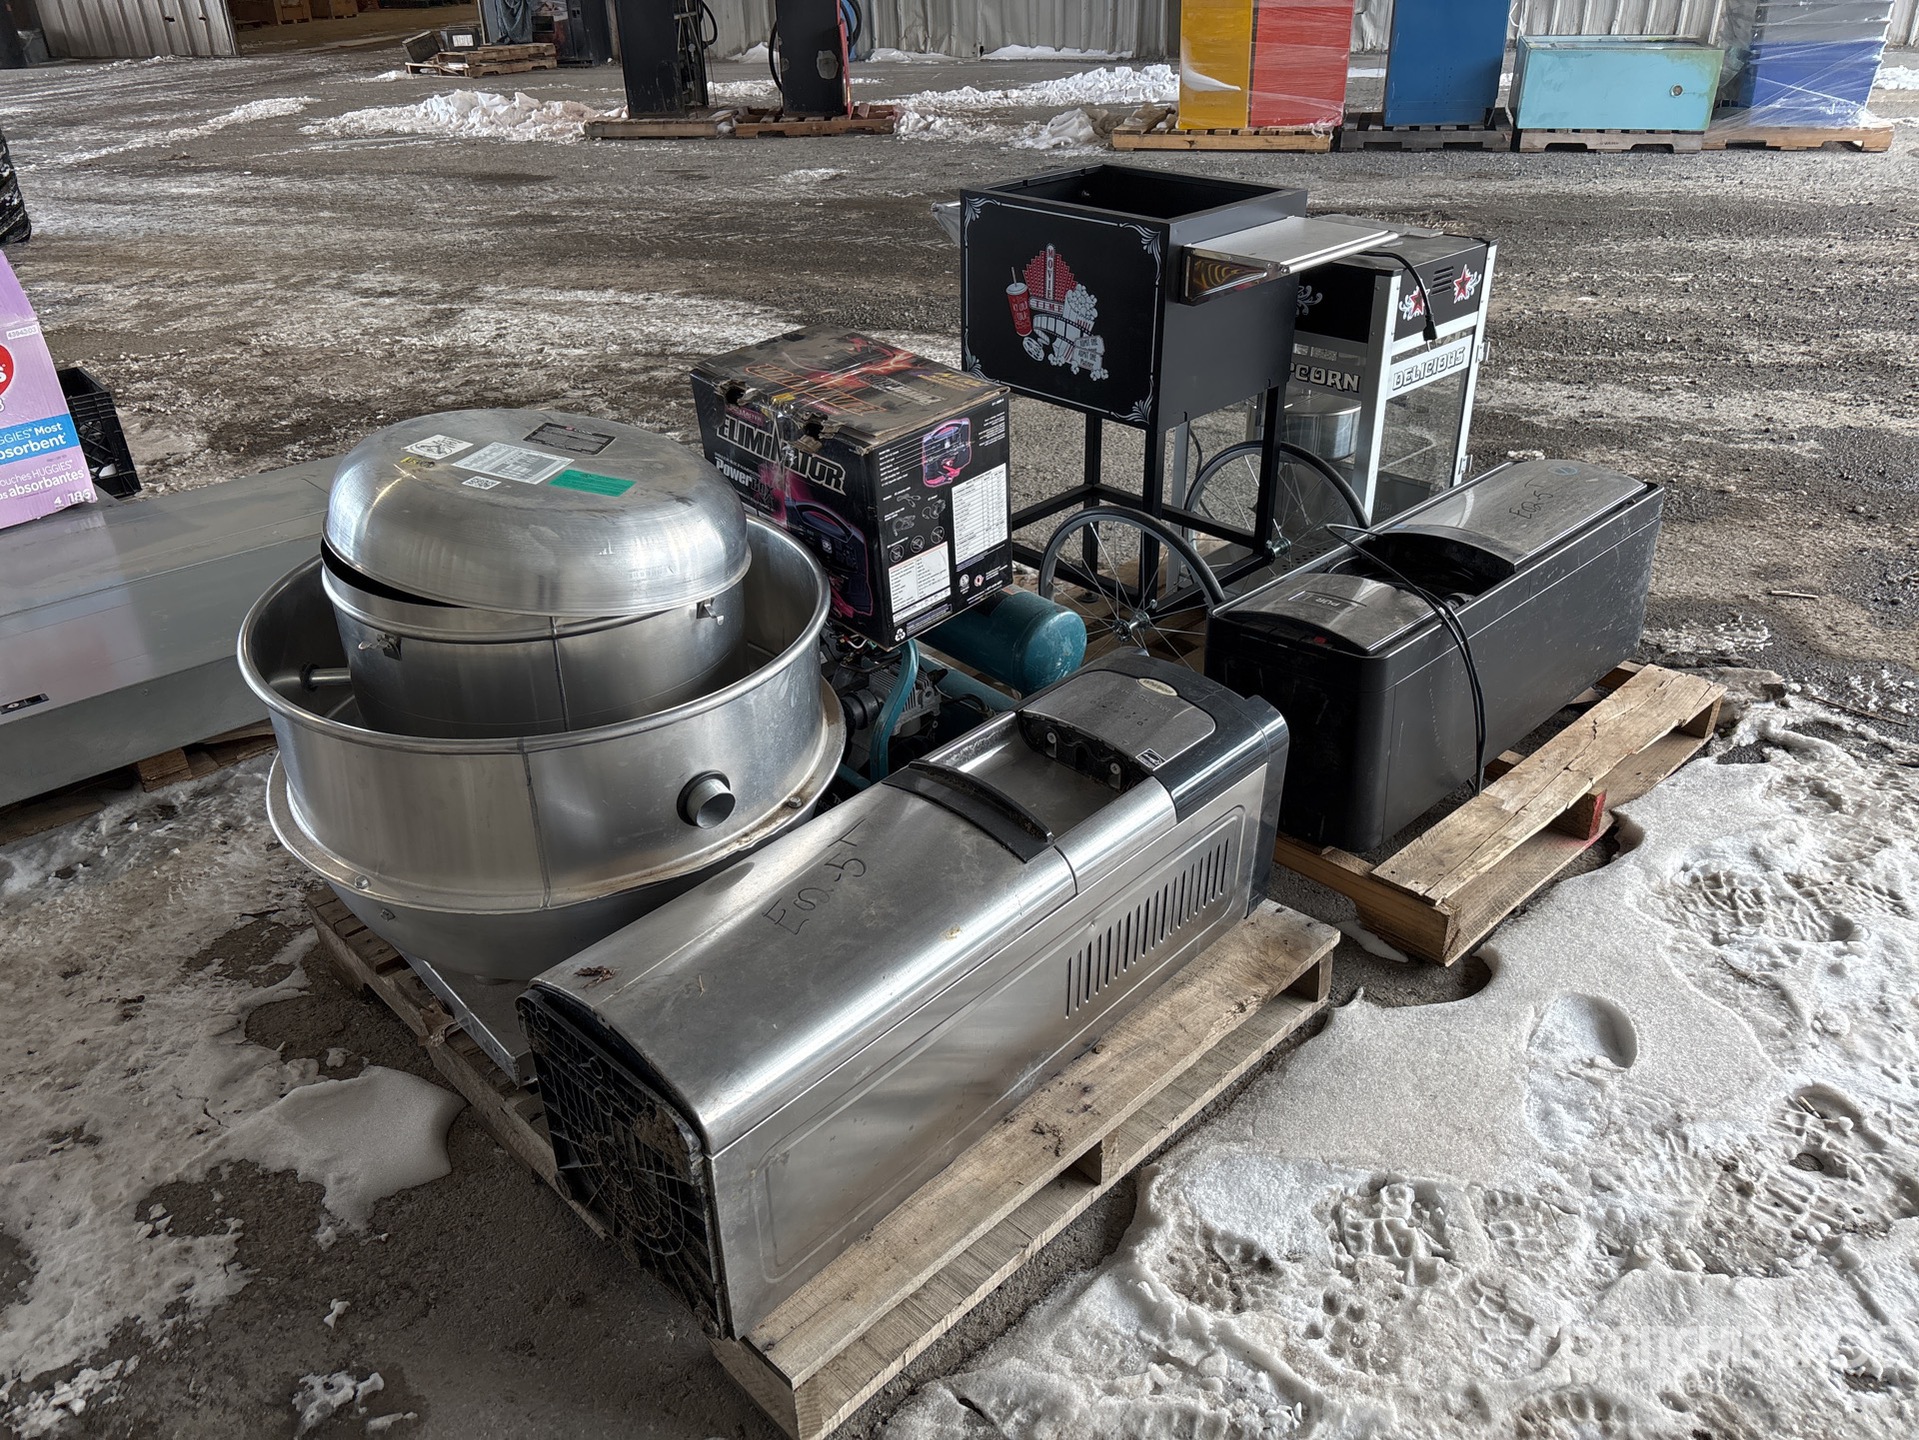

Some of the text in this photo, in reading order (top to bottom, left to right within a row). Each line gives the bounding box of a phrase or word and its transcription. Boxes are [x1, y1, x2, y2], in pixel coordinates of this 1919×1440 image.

[1392, 346, 1466, 391] DELICIOUS
[34, 422, 63, 436] Most
[31, 460, 72, 478] HUGGIES
[9, 469, 84, 497] absorbantes
